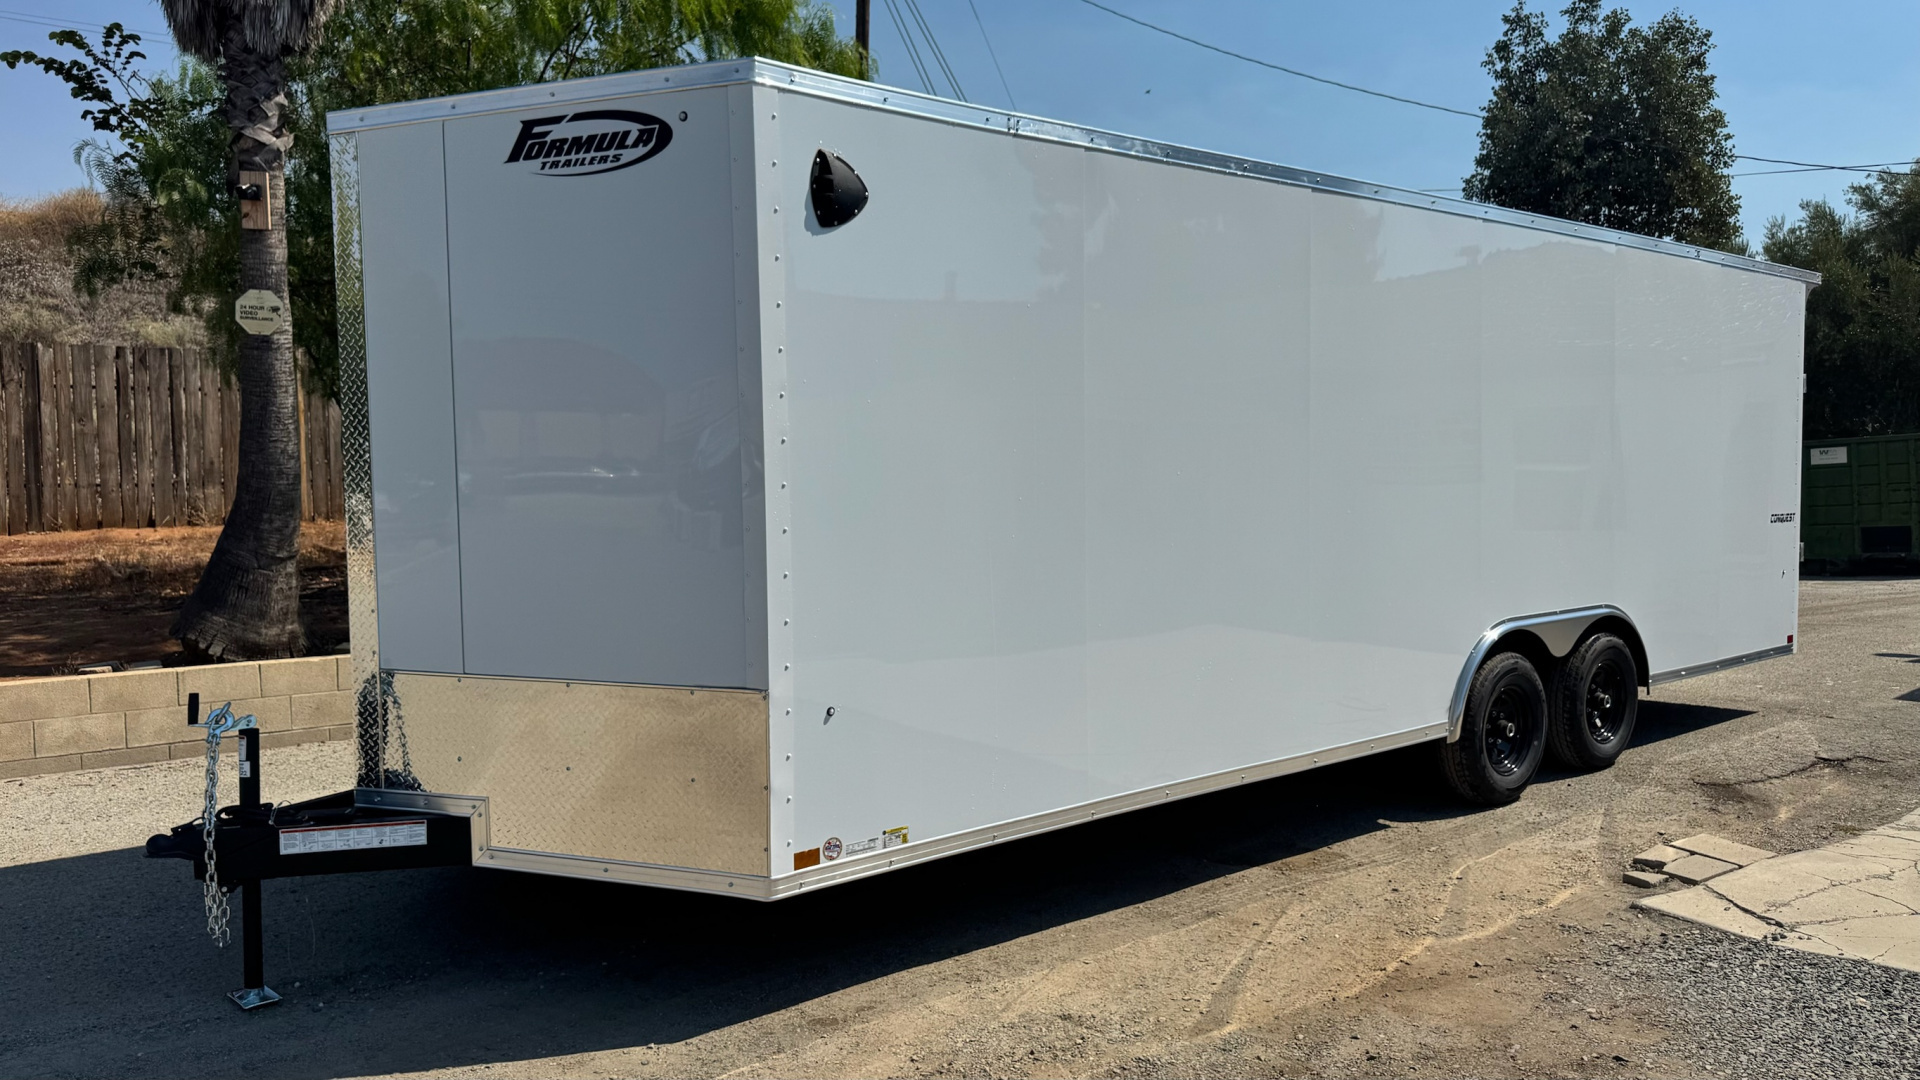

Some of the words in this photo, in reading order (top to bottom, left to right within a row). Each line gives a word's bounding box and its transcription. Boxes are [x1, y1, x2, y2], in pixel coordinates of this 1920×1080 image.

[504, 114, 657, 164] FORMULA
[540, 153, 623, 171] TRAILERS
[1770, 512, 1796, 524] CONQUEST
